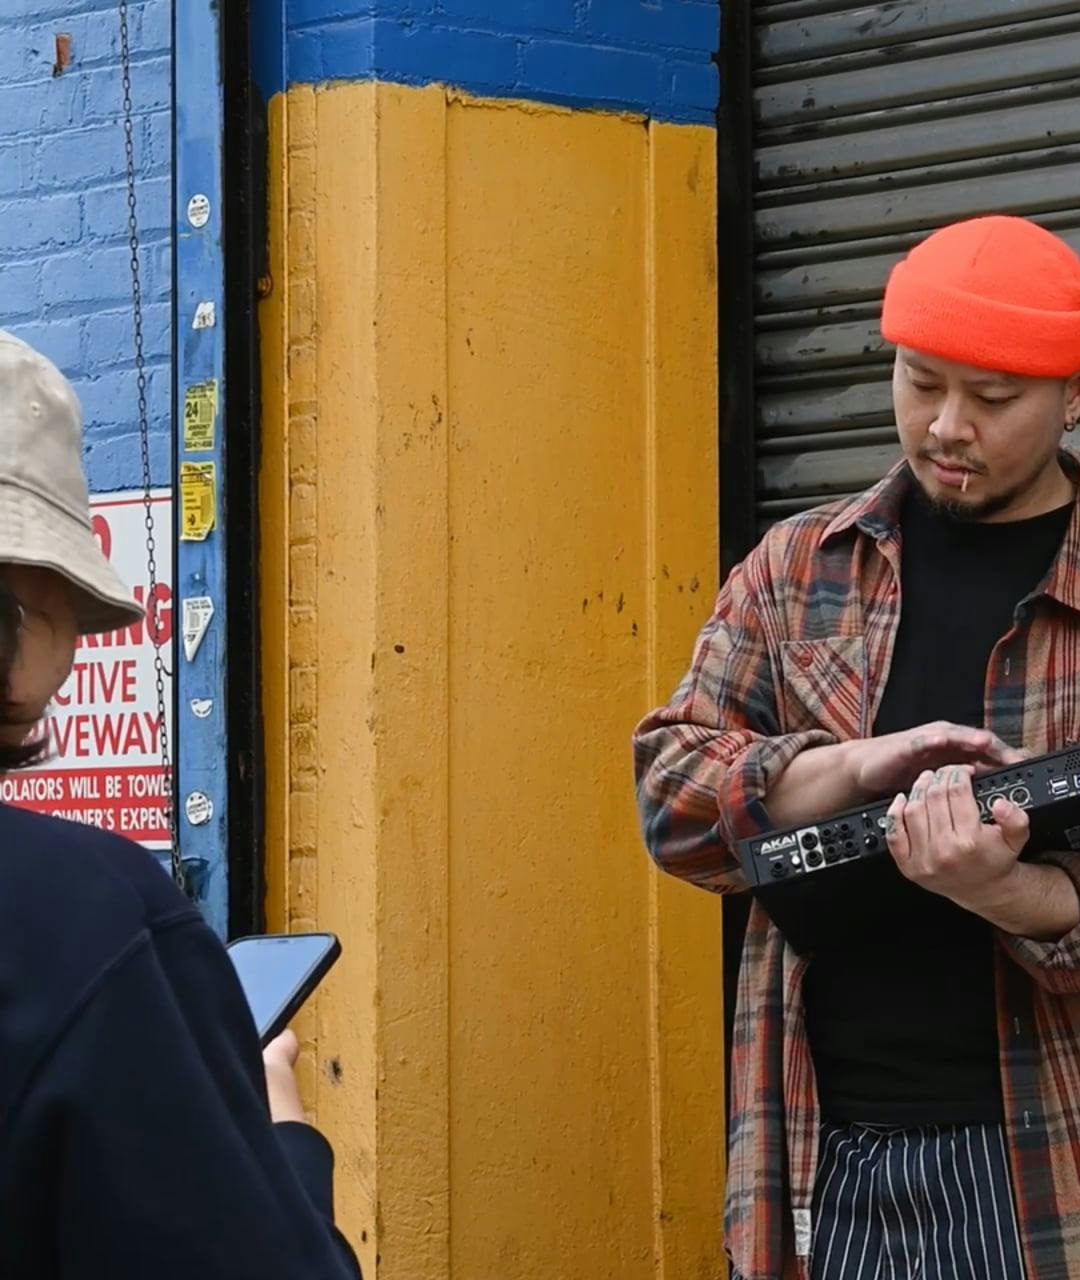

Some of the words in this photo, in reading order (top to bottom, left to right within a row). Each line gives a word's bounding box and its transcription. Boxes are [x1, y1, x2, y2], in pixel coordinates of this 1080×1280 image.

[185, 401, 198, 418] 24
[68, 776, 100, 799] WILL
[105, 775, 122, 798] BE
[127, 774, 173, 798] TOWE
[760, 833, 796, 855] AKAI
